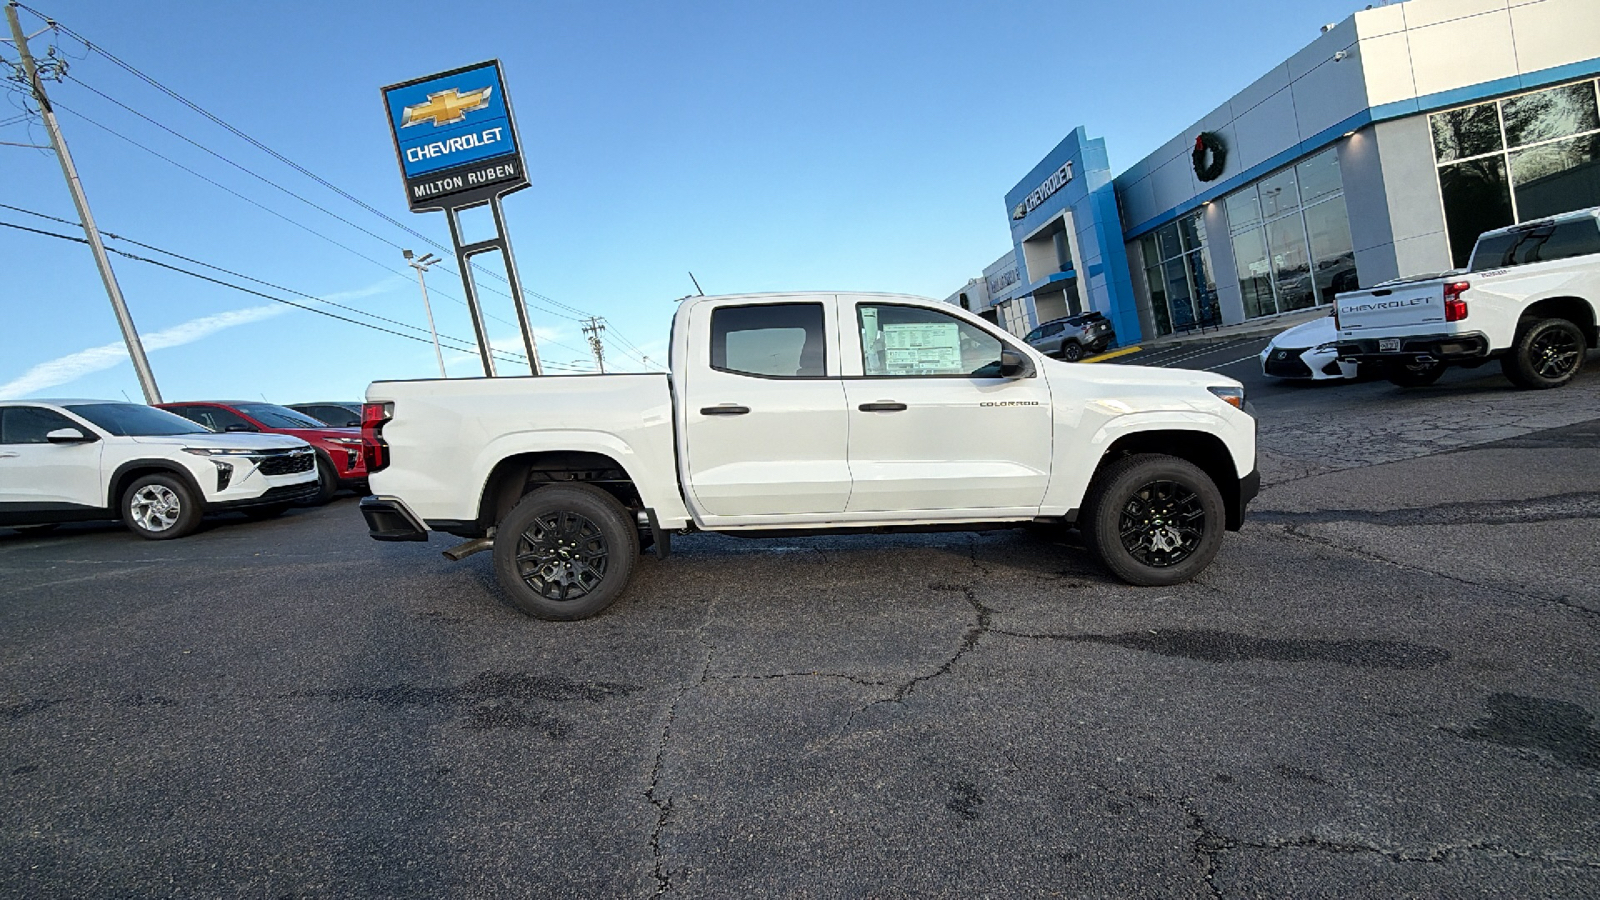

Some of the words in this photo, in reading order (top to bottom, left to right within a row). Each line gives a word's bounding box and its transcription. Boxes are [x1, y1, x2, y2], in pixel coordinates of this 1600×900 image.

[406, 127, 502, 163] CHEVROLET
[414, 176, 463, 198] MILTON
[467, 163, 515, 185] RUBEN
[1025, 160, 1073, 213] CHEVROLET
[1341, 297, 1433, 314] CHEVROLET
